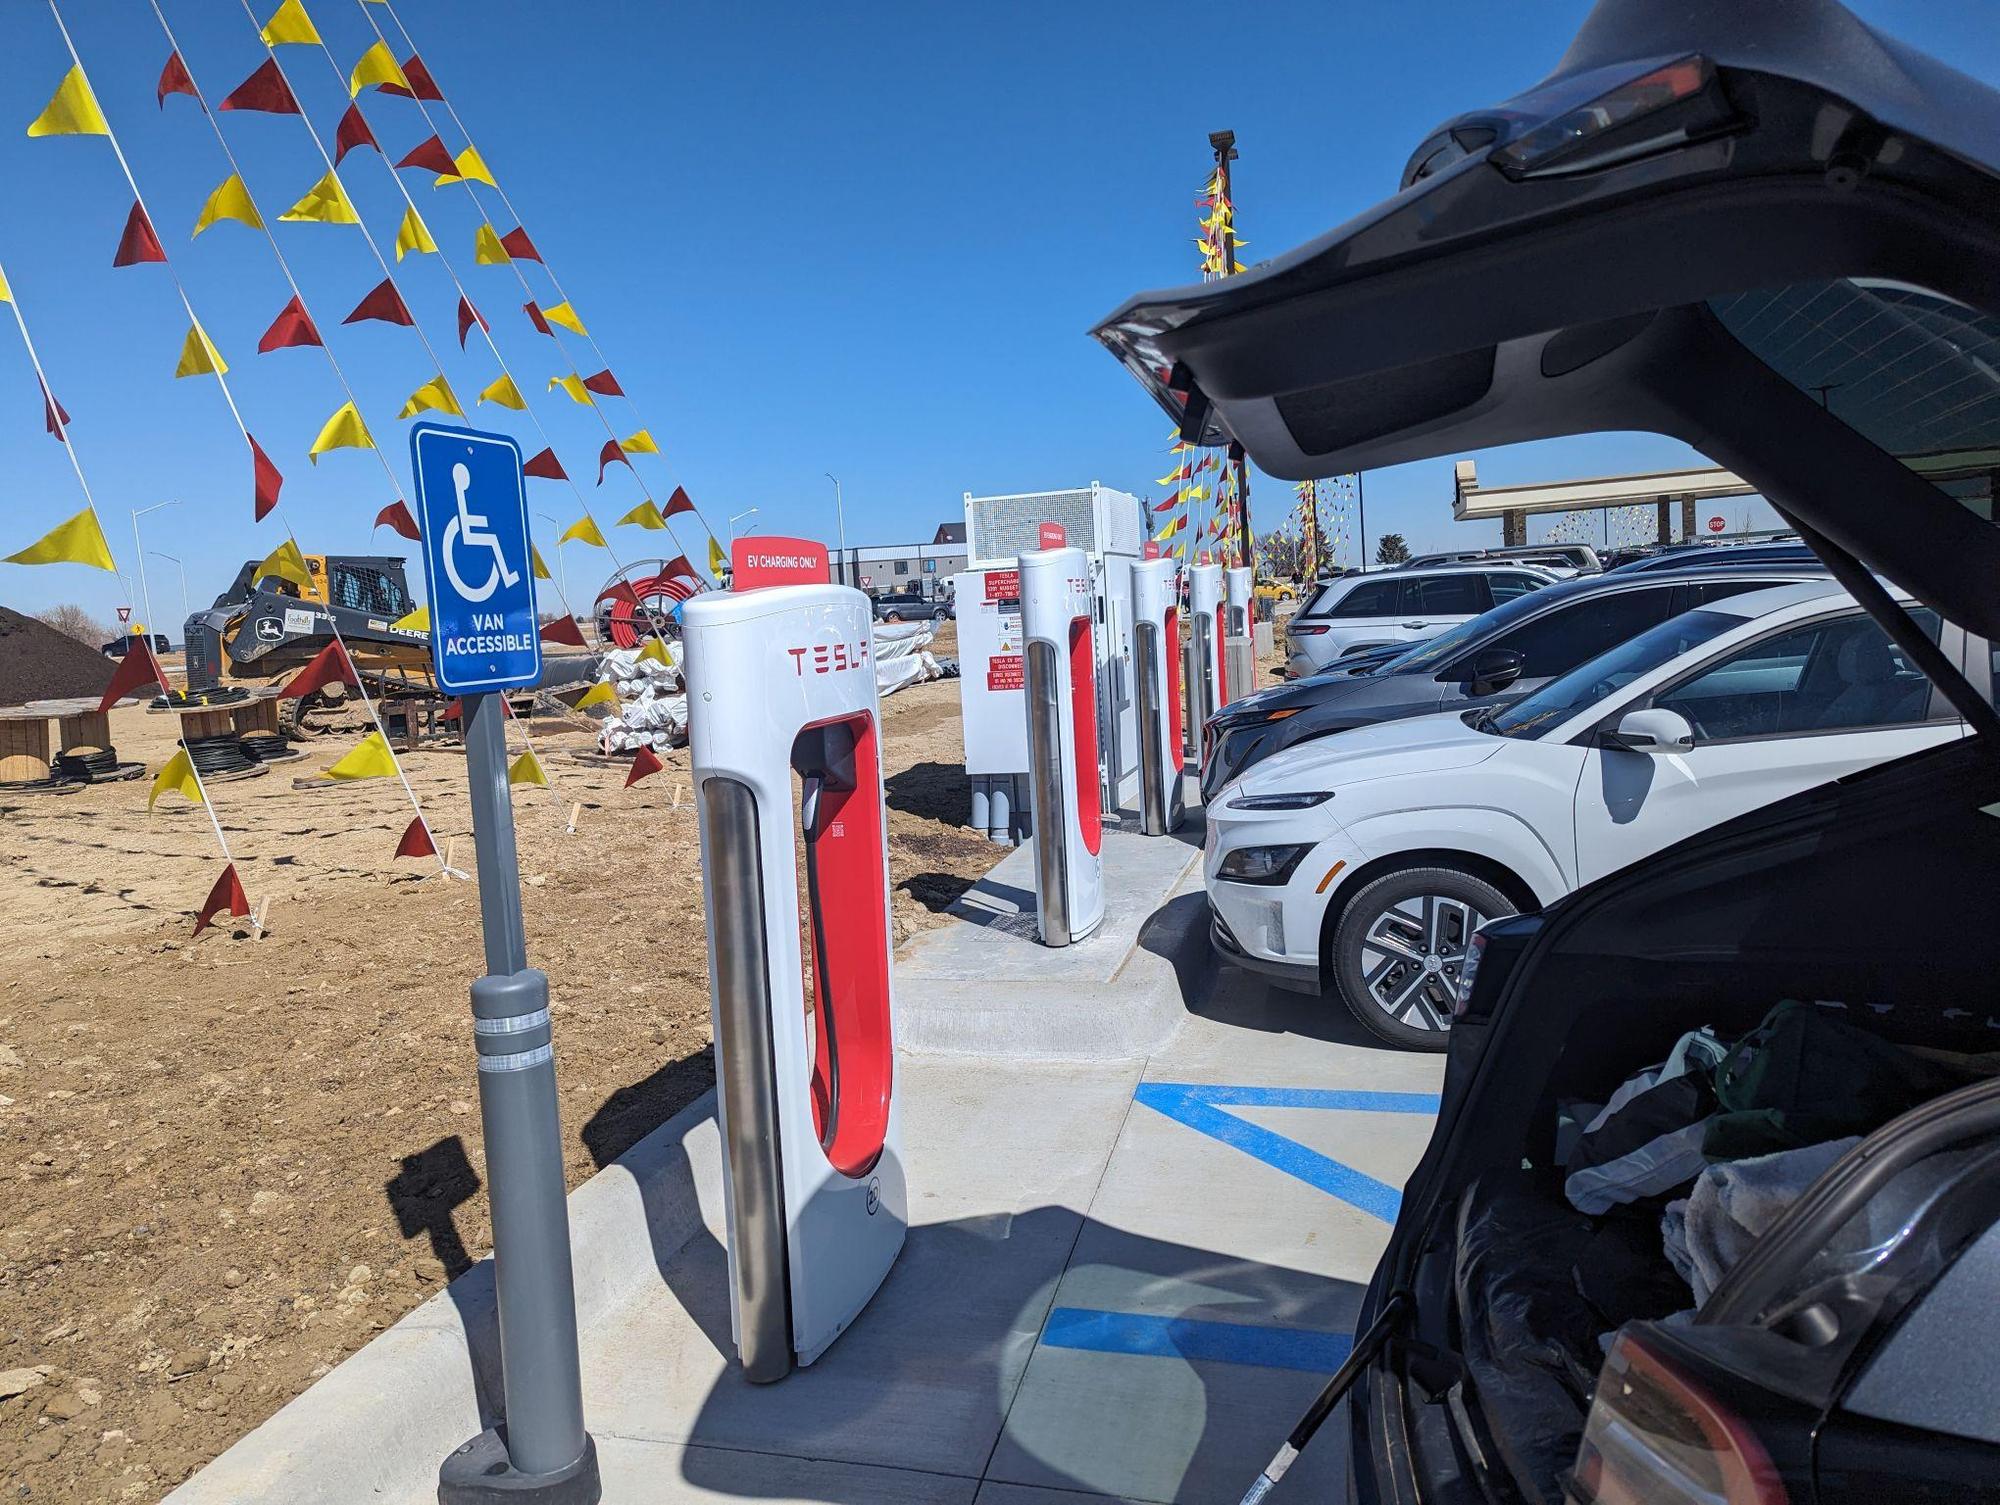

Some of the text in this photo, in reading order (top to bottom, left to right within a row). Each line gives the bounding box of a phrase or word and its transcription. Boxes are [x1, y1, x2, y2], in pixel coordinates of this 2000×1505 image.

[1709, 520, 1725, 528] STOP
[748, 555, 817, 569] EV CHARGING ONLY
[472, 613, 505, 631] VAN
[389, 626, 429, 640] DEERE
[446, 633, 532, 656] ACCESSIBLE
[788, 641, 869, 676] TESLA
